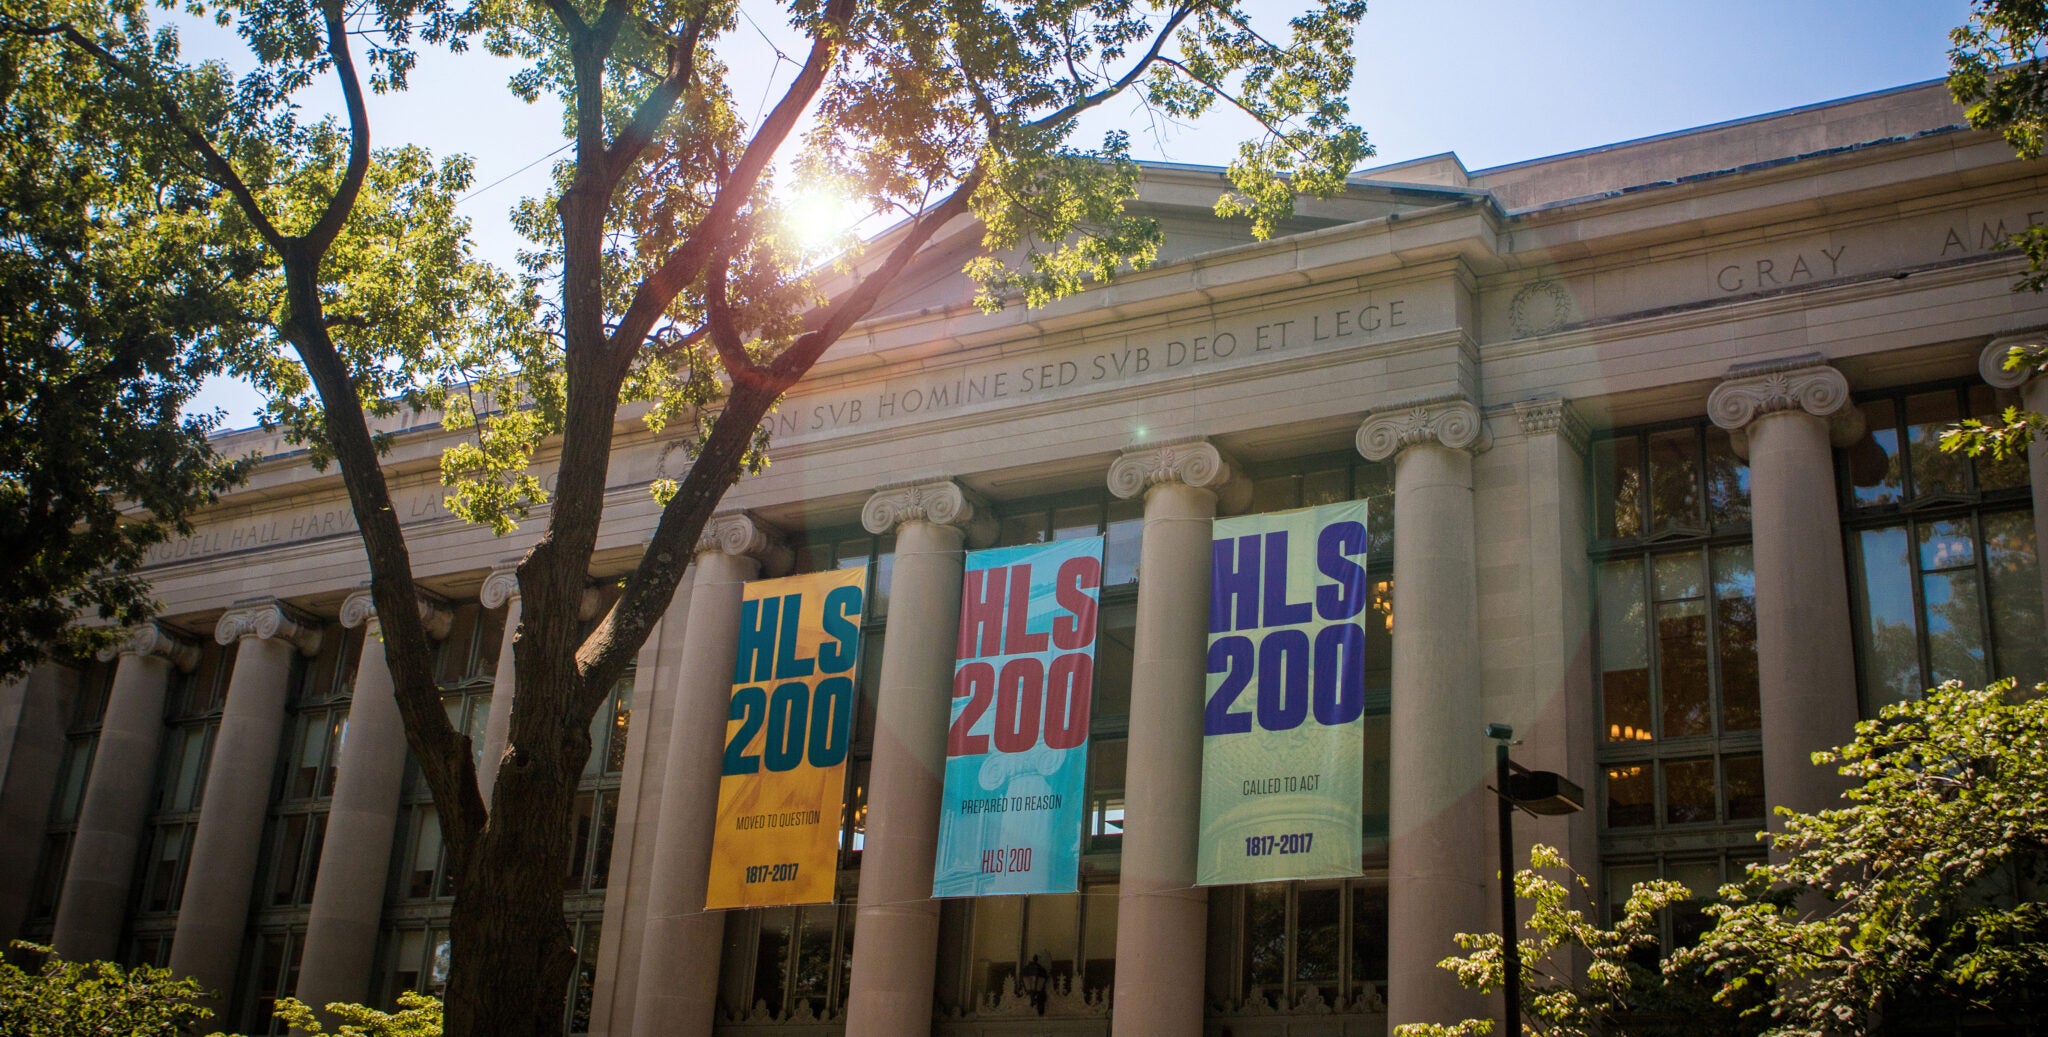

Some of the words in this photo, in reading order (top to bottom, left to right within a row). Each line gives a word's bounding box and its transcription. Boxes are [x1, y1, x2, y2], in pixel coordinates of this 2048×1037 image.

[1716, 246, 1846, 293] GRAY
[761, 411, 798, 436] ON
[811, 399, 862, 430] SVB
[877, 372, 1008, 418] HOMINE
[1020, 360, 1077, 394] SED
[1092, 347, 1151, 381] SVB
[1166, 332, 1237, 367] DEO
[1255, 320, 1295, 352] ET
[1313, 300, 1407, 342] LEGE
[147, 532, 222, 561] NGDELL
[231, 521, 280, 550] HALL
[289, 508, 354, 538] HARV
[955, 555, 1101, 661] HLS
[1209, 520, 1367, 634] HLS
[732, 585, 863, 685] HLS
[946, 652, 1094, 757] 200
[1204, 622, 1366, 737] 200
[721, 676, 854, 777] 200
[736, 814, 765, 831] MOVED
[767, 814, 777, 828] TO
[779, 809, 821, 827] QUESTION
[962, 798, 1008, 815] PREPARED
[1011, 797, 1023, 812] TO
[1024, 794, 1062, 811] REASON
[1242, 777, 1281, 796] CALLED
[1284, 776, 1297, 793] TO
[1299, 774, 1321, 792] ACT
[745, 863, 799, 883] 1817-2017
[1245, 833, 1313, 857] 1817-2017
